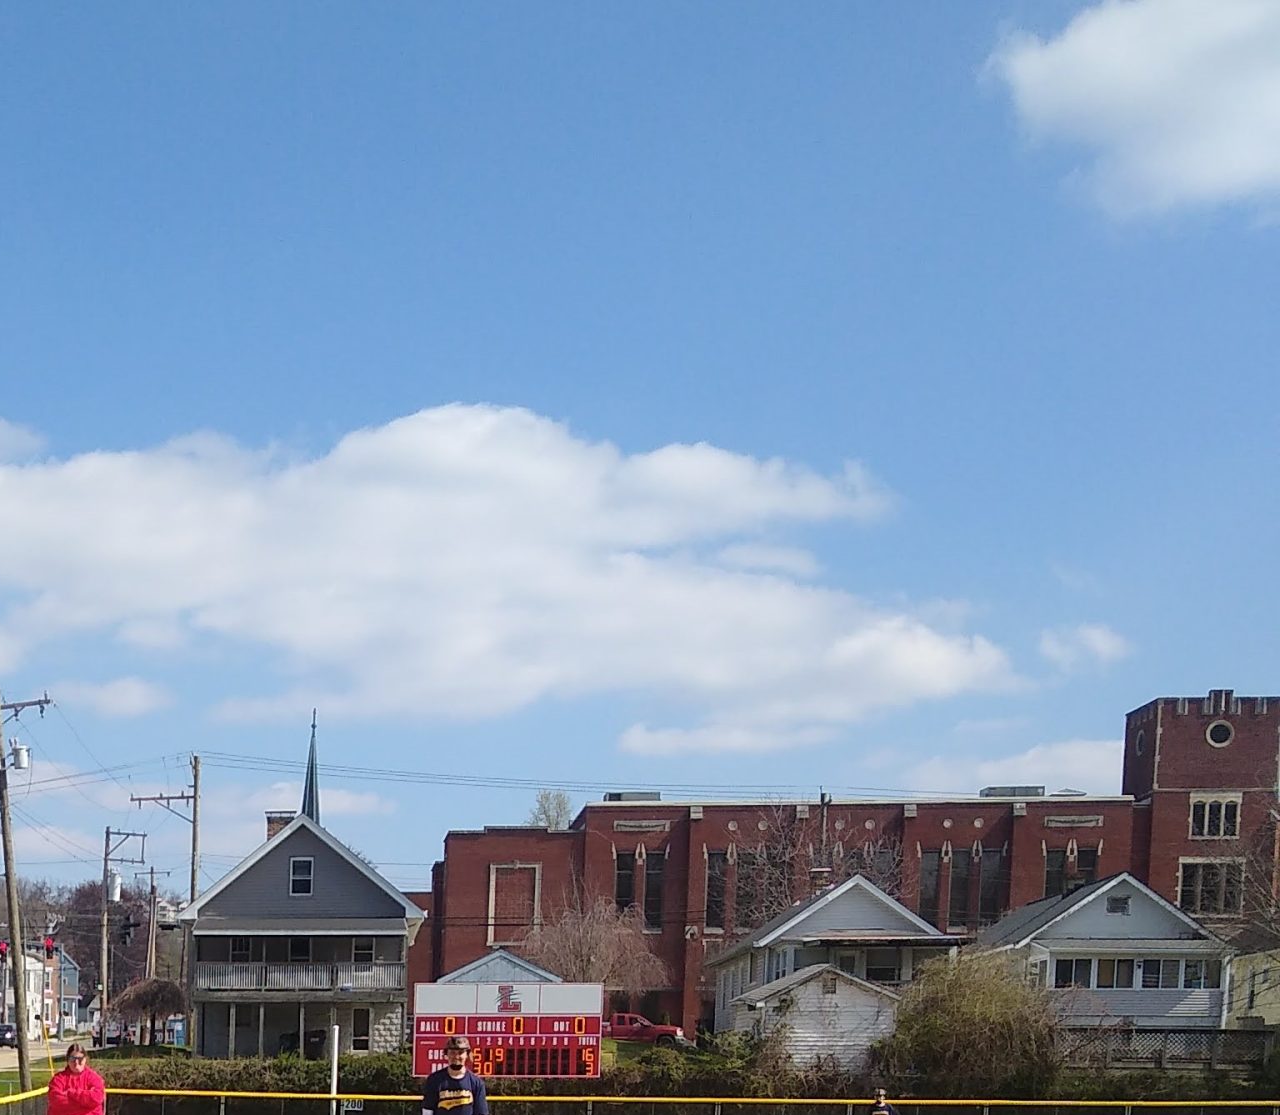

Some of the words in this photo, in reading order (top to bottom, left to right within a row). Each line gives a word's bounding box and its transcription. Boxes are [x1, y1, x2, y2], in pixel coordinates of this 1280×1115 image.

[497, 985, 521, 1012] L
[420, 1021, 439, 1032] BALL
[444, 1016, 456, 1035] 0
[477, 1021, 506, 1032] STRIKE
[512, 1016, 524, 1035] 0
[553, 1021, 570, 1032] OUT
[574, 1016, 586, 1035] 0
[578, 1037, 597, 1046] TOTAL
[428, 1049, 445, 1060] GUE
[582, 1048, 594, 1062] 16
[586, 1062, 594, 1075] 3
[345, 1099, 363, 1109] 200
